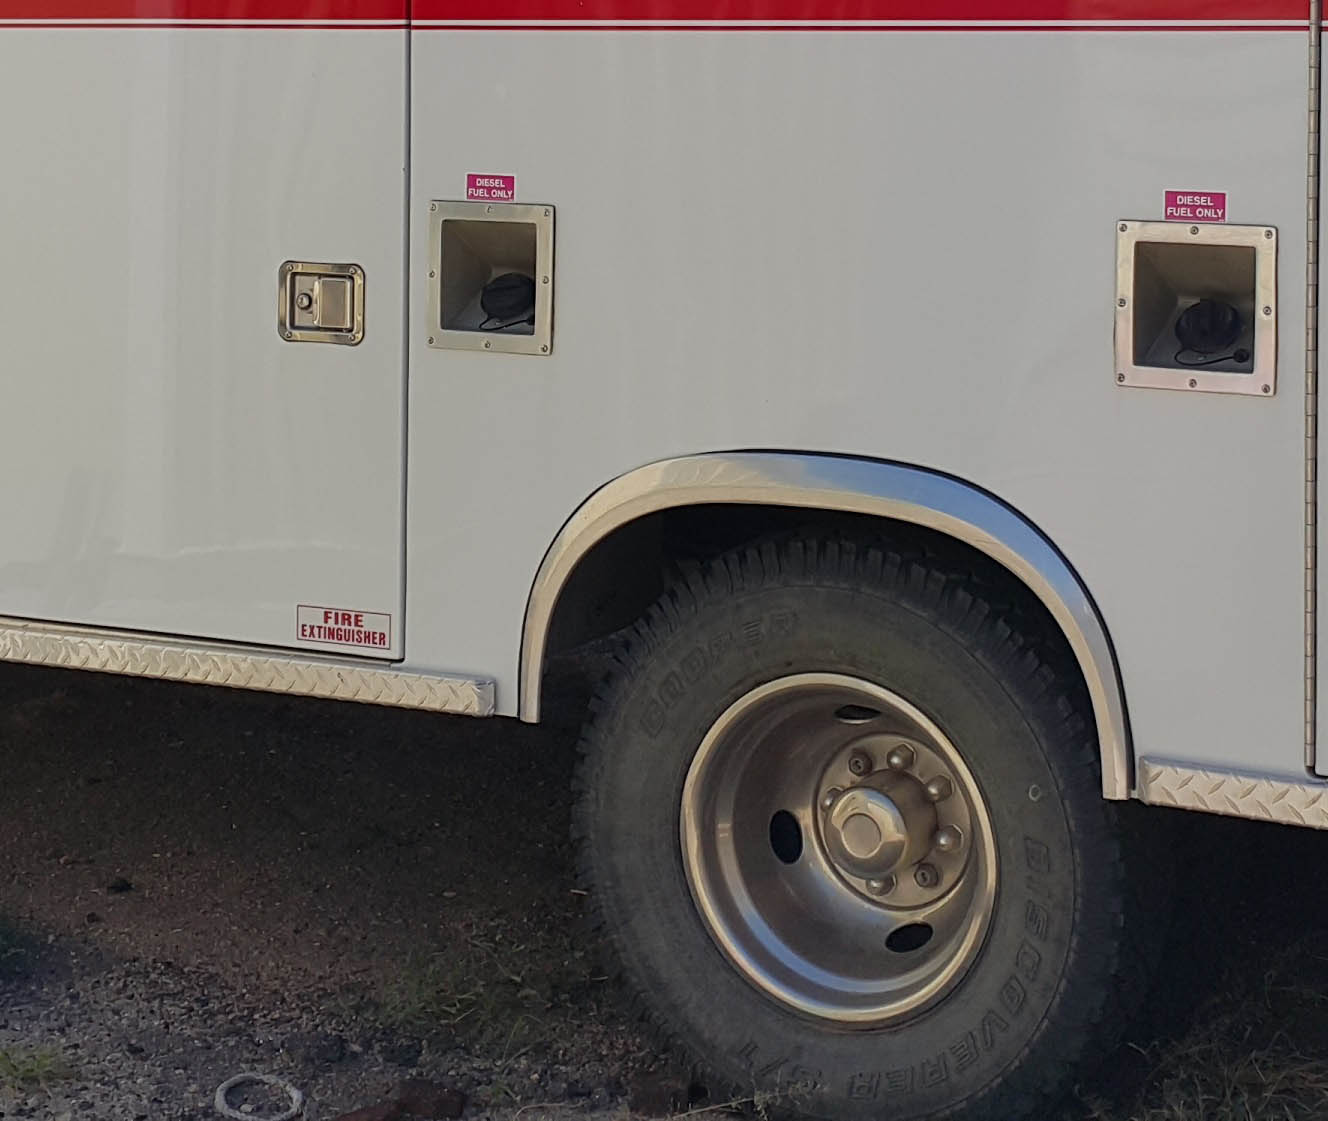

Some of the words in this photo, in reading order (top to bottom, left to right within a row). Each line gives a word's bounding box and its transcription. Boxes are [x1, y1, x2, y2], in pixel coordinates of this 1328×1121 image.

[476, 178, 506, 188] DIESEL
[468, 187, 490, 197] FUEL
[491, 189, 513, 199] ONLY
[1176, 195, 1215, 206] DIESEL
[1166, 206, 1194, 217] FUEL
[1195, 207, 1224, 218] ONLY
[323, 610, 364, 628] FIRE
[301, 624, 386, 646] EXTINGUISHER
